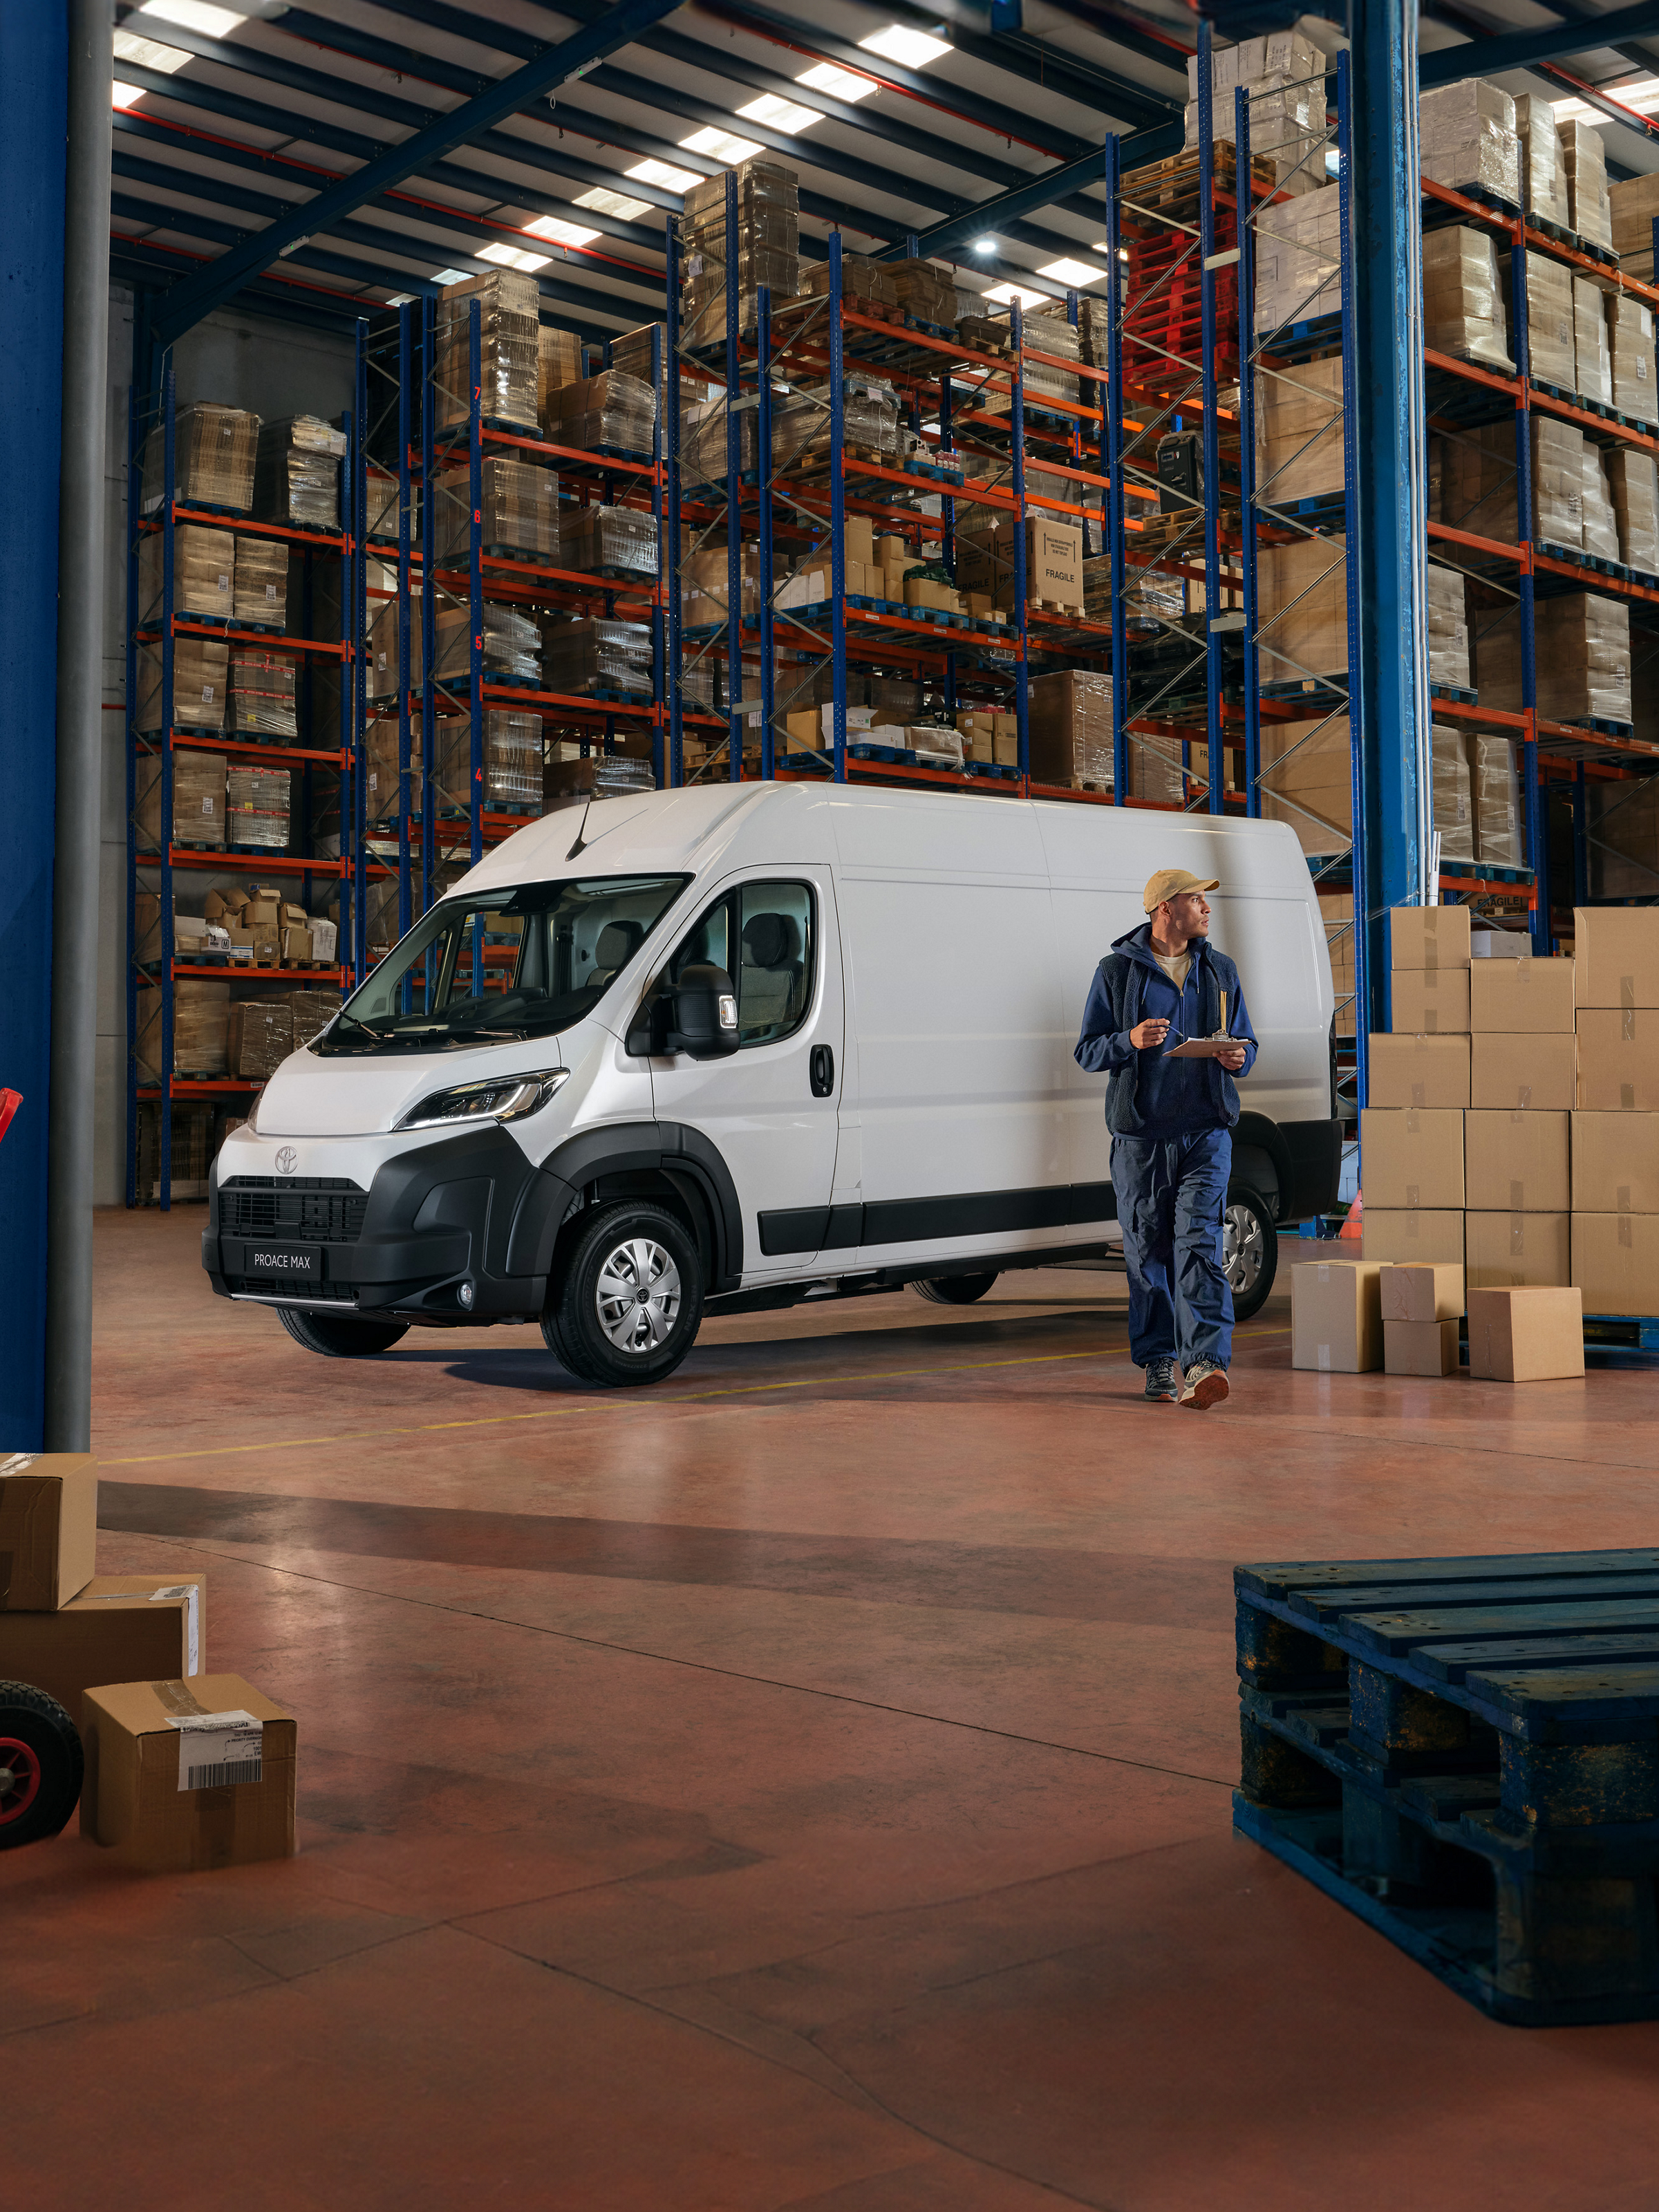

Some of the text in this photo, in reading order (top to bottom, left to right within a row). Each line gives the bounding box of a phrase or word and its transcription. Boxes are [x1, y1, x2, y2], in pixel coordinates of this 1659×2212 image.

[474, 386, 480, 400] 7
[475, 510, 480, 523] 6
[1046, 569, 1075, 583] FRAGILE
[958, 578, 989, 592] FRAGILE
[476, 636, 482, 649] 5
[475, 768, 482, 781] 4
[254, 1253, 310, 1268] PROACE MAX
[684, 1284, 697, 1331] NEXEN
